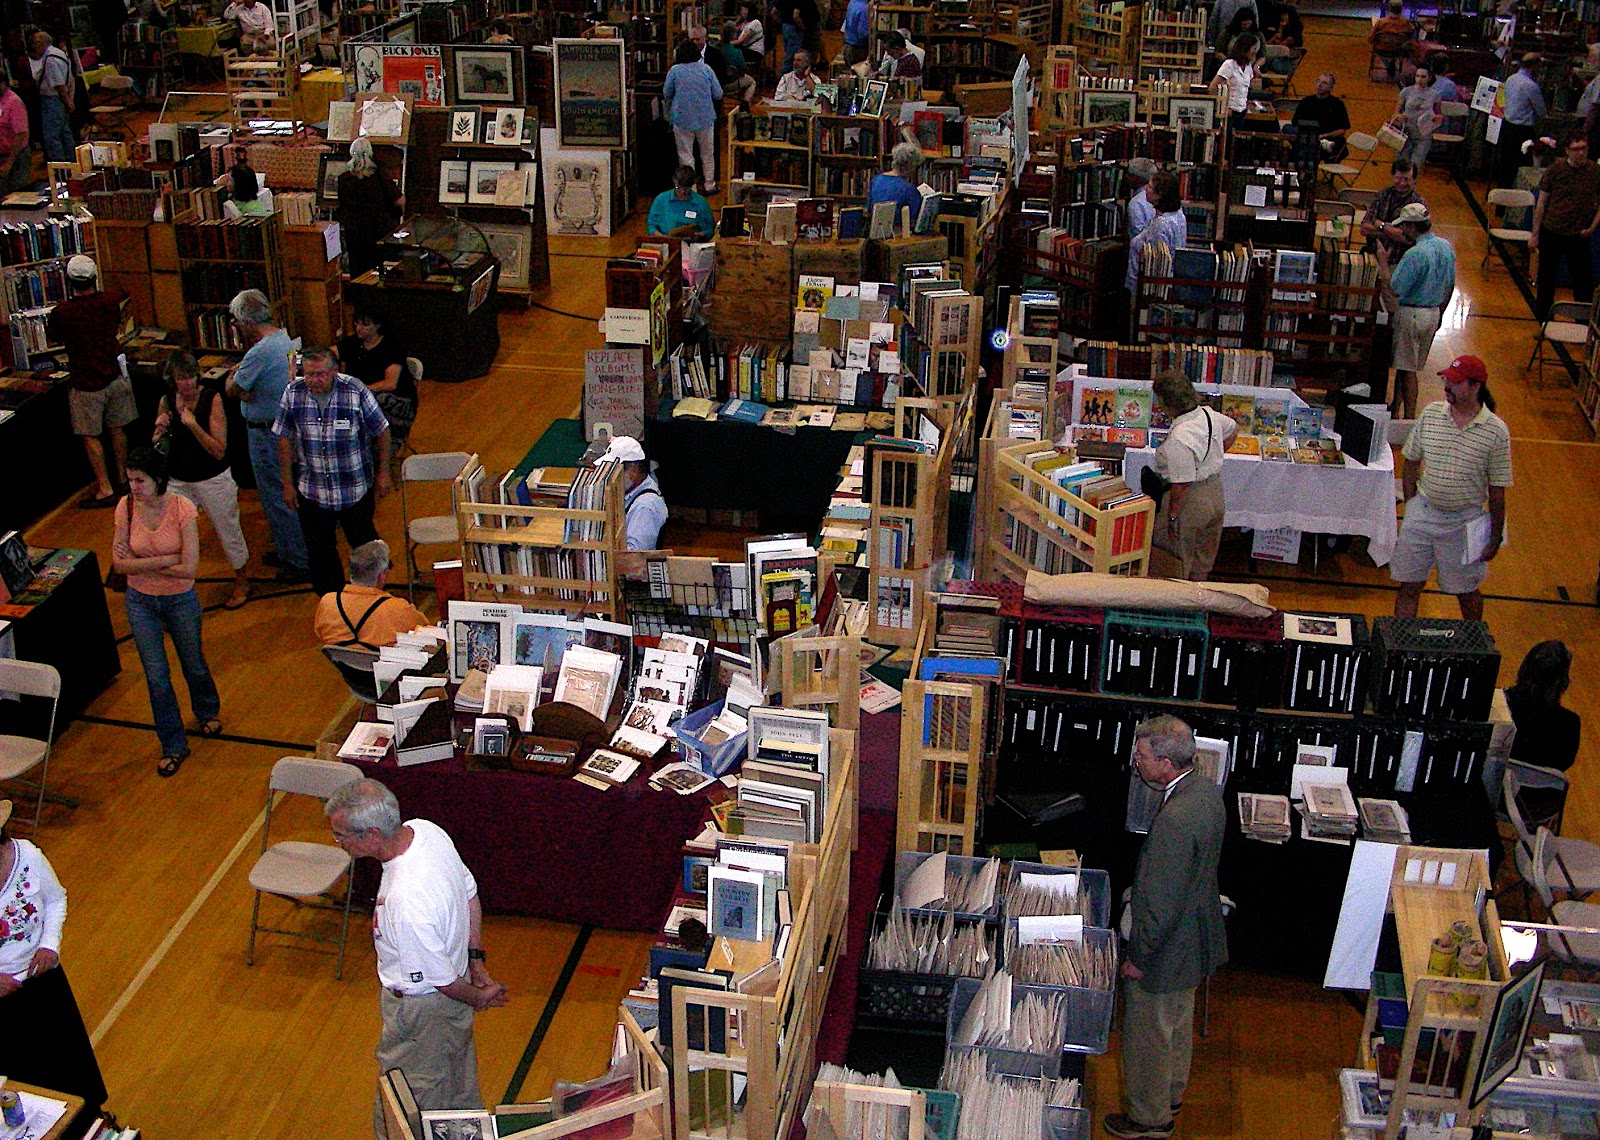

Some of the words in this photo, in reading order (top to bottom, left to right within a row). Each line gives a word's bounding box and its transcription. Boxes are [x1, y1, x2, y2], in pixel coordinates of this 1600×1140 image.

[382, 46, 409, 56] BUCK
[410, 46, 440, 56] JONES
[563, 107, 586, 115] SOUTH
[587, 107, 619, 116] AMERICA
[586, 351, 636, 363] REPLACE
[595, 364, 636, 374] ALBUMS
